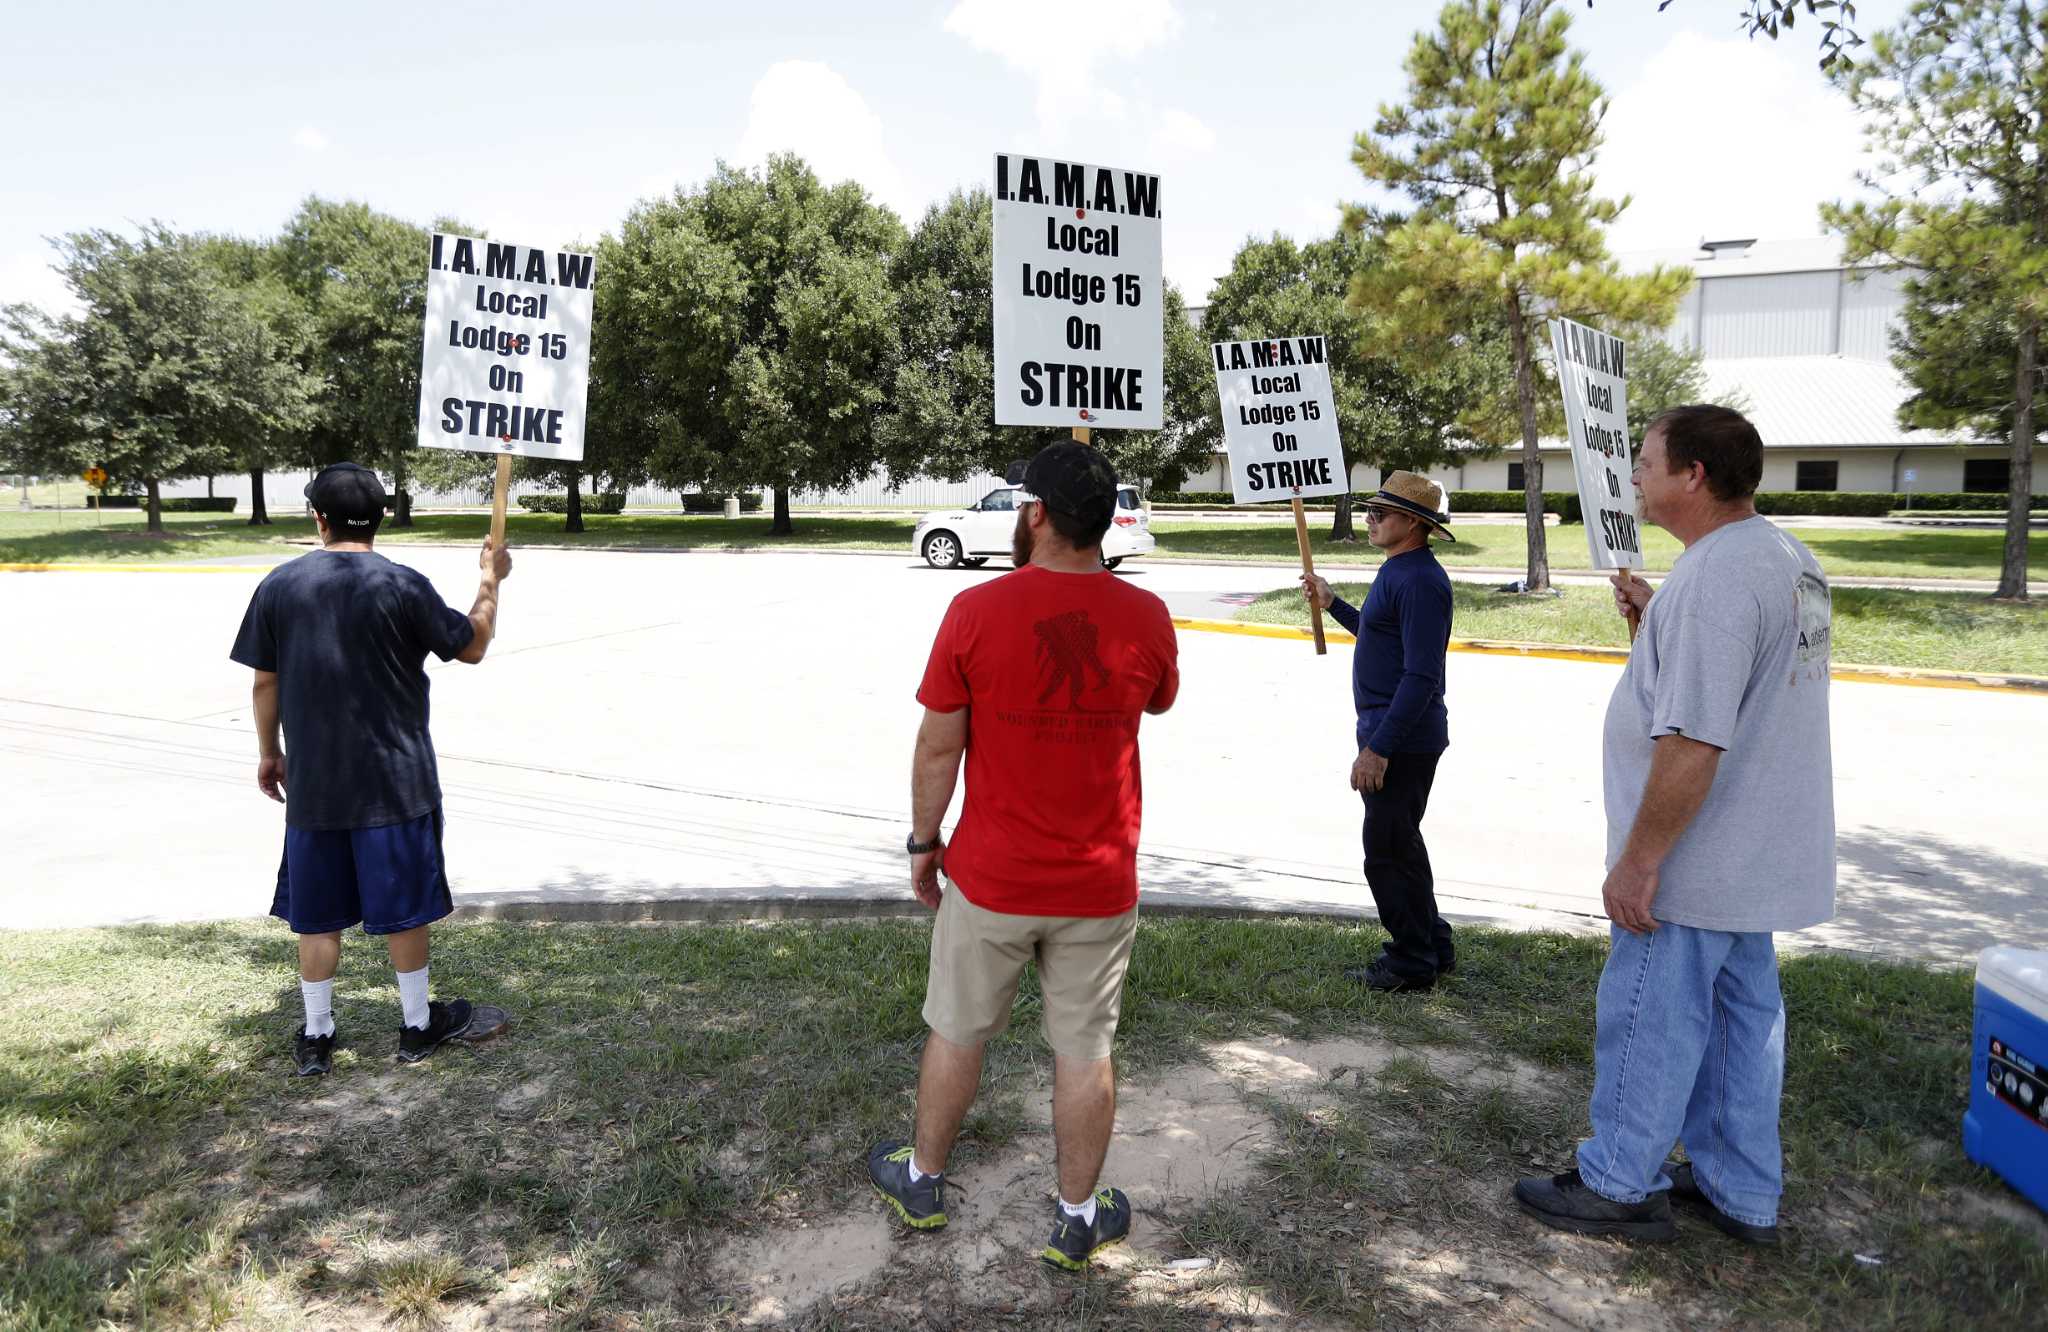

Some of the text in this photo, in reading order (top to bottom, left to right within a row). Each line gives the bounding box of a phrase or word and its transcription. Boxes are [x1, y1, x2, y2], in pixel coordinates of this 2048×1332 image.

[997, 155, 1161, 219] I.A.M.A.W.
[1047, 216, 1119, 257] Local
[431, 234, 594, 290] I.A.M.A.W.
[476, 285, 548, 319] Local
[1022, 263, 1141, 307] Lodge 15
[449, 320, 567, 360] Lodge 15
[1066, 315, 1101, 350] On
[1215, 337, 1328, 371] I.A.M.A.W.
[489, 364, 524, 393] On
[1020, 361, 1142, 411] STRIKE
[1251, 372, 1301, 395] Local
[1586, 377, 1613, 414] Local
[441, 397, 564, 444] STRIKE
[1239, 400, 1320, 425] Lodge 15
[1272, 431, 1298, 453] On
[1583, 418, 1625, 459] Lodge 15
[1246, 458, 1332, 491] STRIKE
[1606, 467, 1621, 498] On
[1600, 509, 1639, 553] STRIKE
